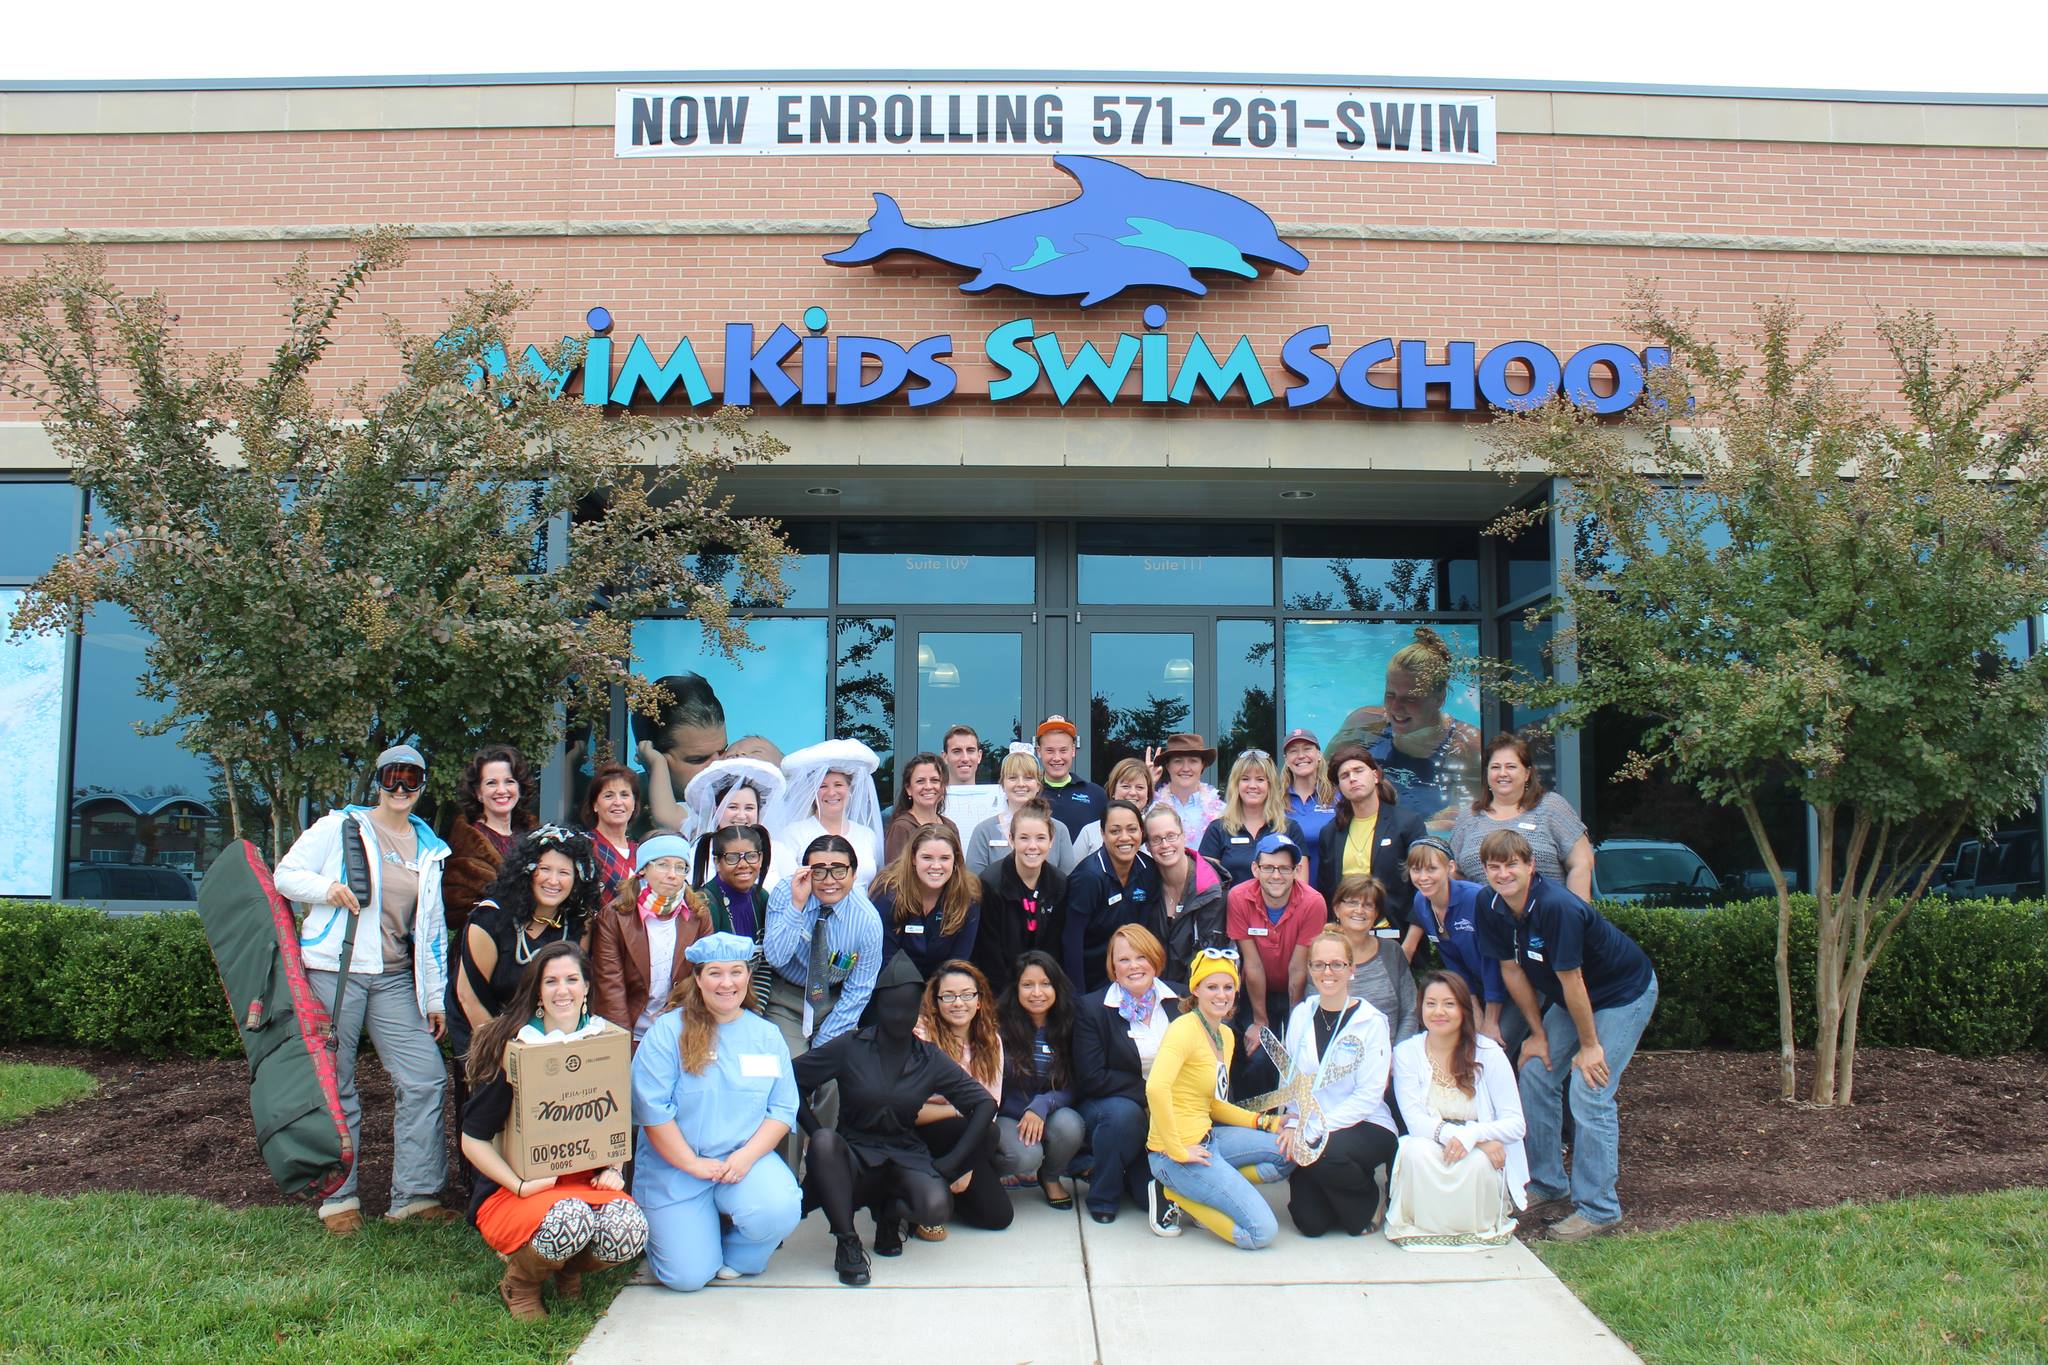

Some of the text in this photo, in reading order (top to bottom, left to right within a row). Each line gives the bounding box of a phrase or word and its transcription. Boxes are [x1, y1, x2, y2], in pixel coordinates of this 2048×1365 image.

[631, 93, 1480, 153] NOW ENROLLING 571-261-SWIM
[725, 306, 958, 408] KiDS
[985, 304, 1275, 408] SWiM
[905, 557, 969, 571] Suite 109
[1144, 558, 1179, 571] Suite
[561, 1087, 598, 1101] anti-viral
[537, 1090, 619, 1122] Kleenex
[532, 1146, 548, 1163] 00
[550, 1138, 590, 1160] 25836
[550, 1159, 573, 1171] 36000
